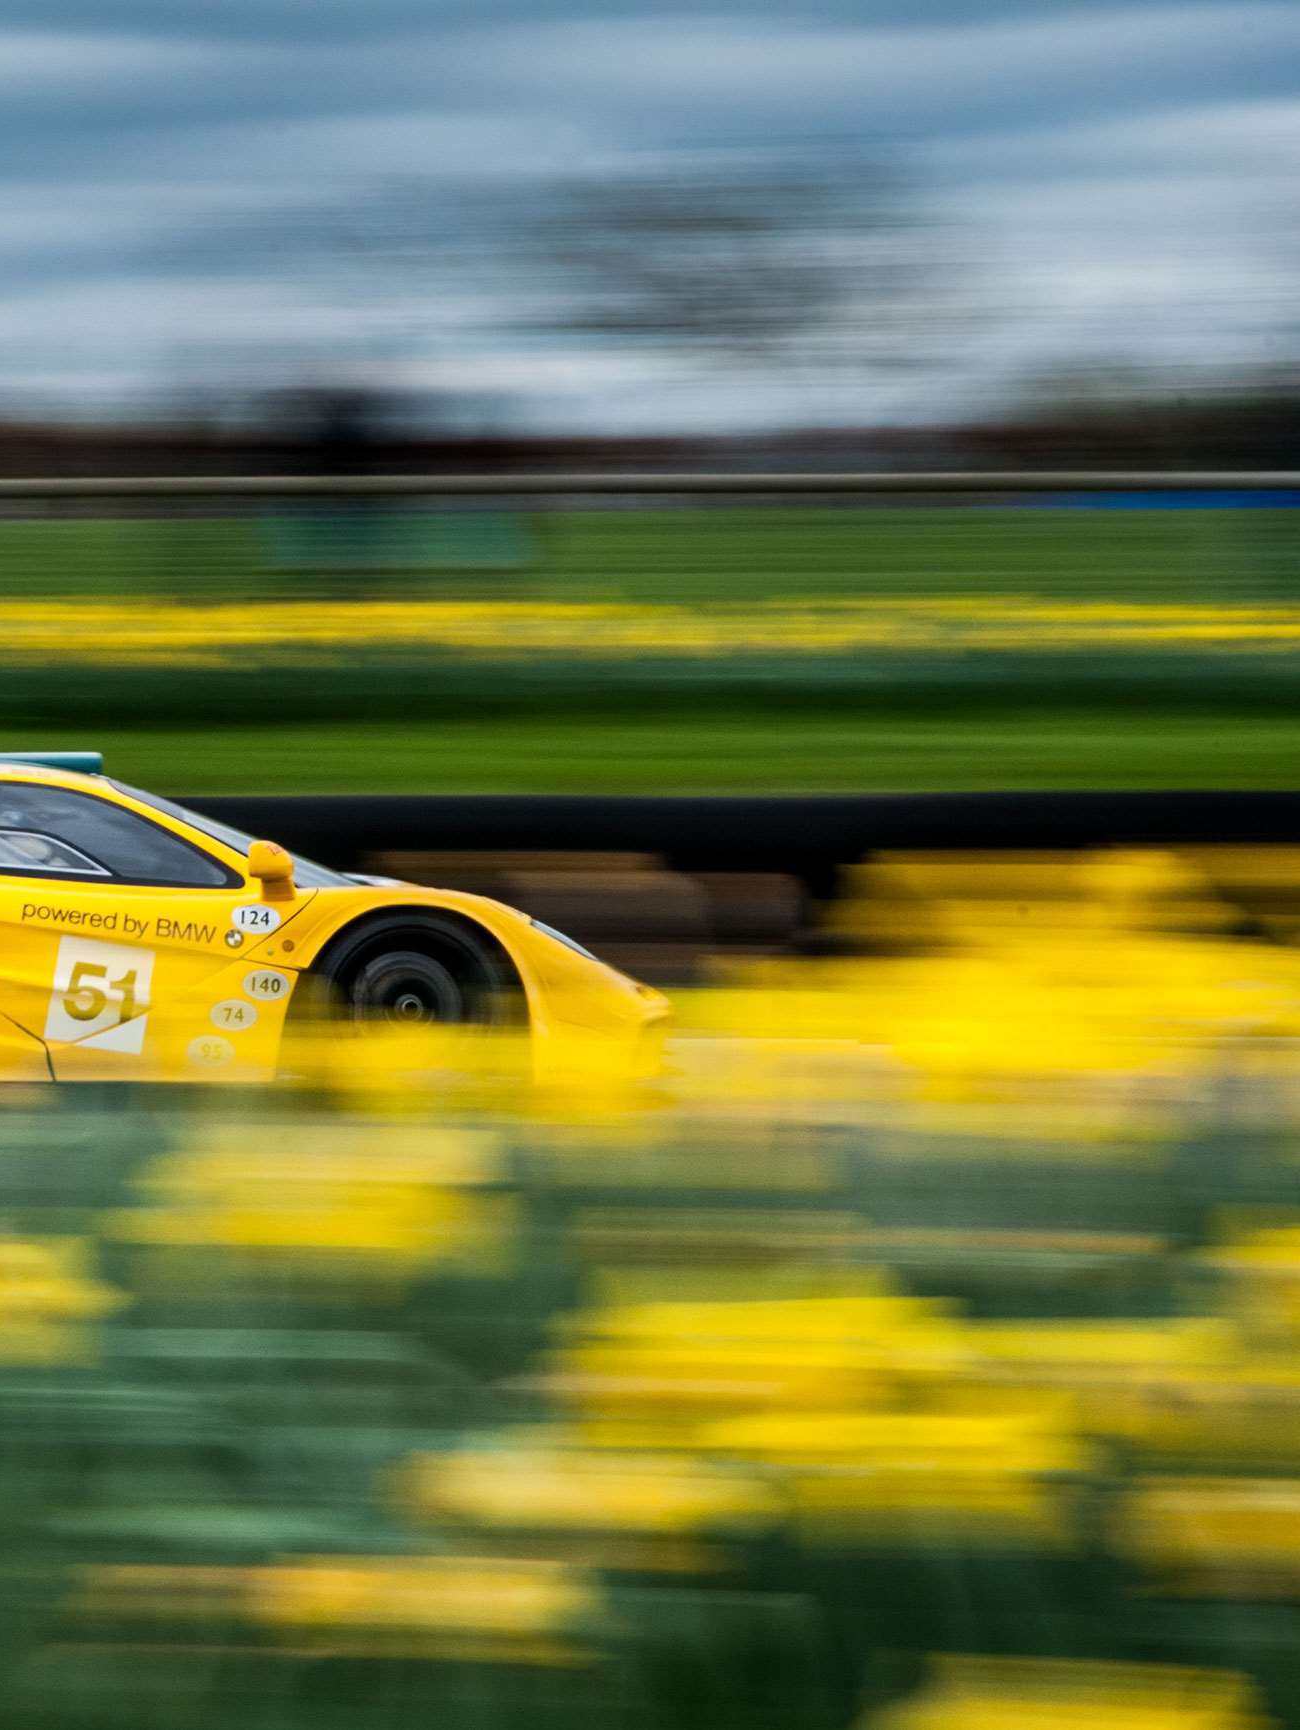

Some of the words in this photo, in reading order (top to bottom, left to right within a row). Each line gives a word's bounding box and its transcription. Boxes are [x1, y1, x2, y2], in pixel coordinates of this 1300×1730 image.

[21, 903, 118, 930] powered
[123, 914, 149, 938] by
[155, 918, 217, 943] BMW
[240, 910, 270, 926] 124
[63, 961, 137, 1025] 51
[251, 977, 281, 993] 140
[223, 1007, 245, 1023] 74
[201, 1043, 222, 1060] 95
